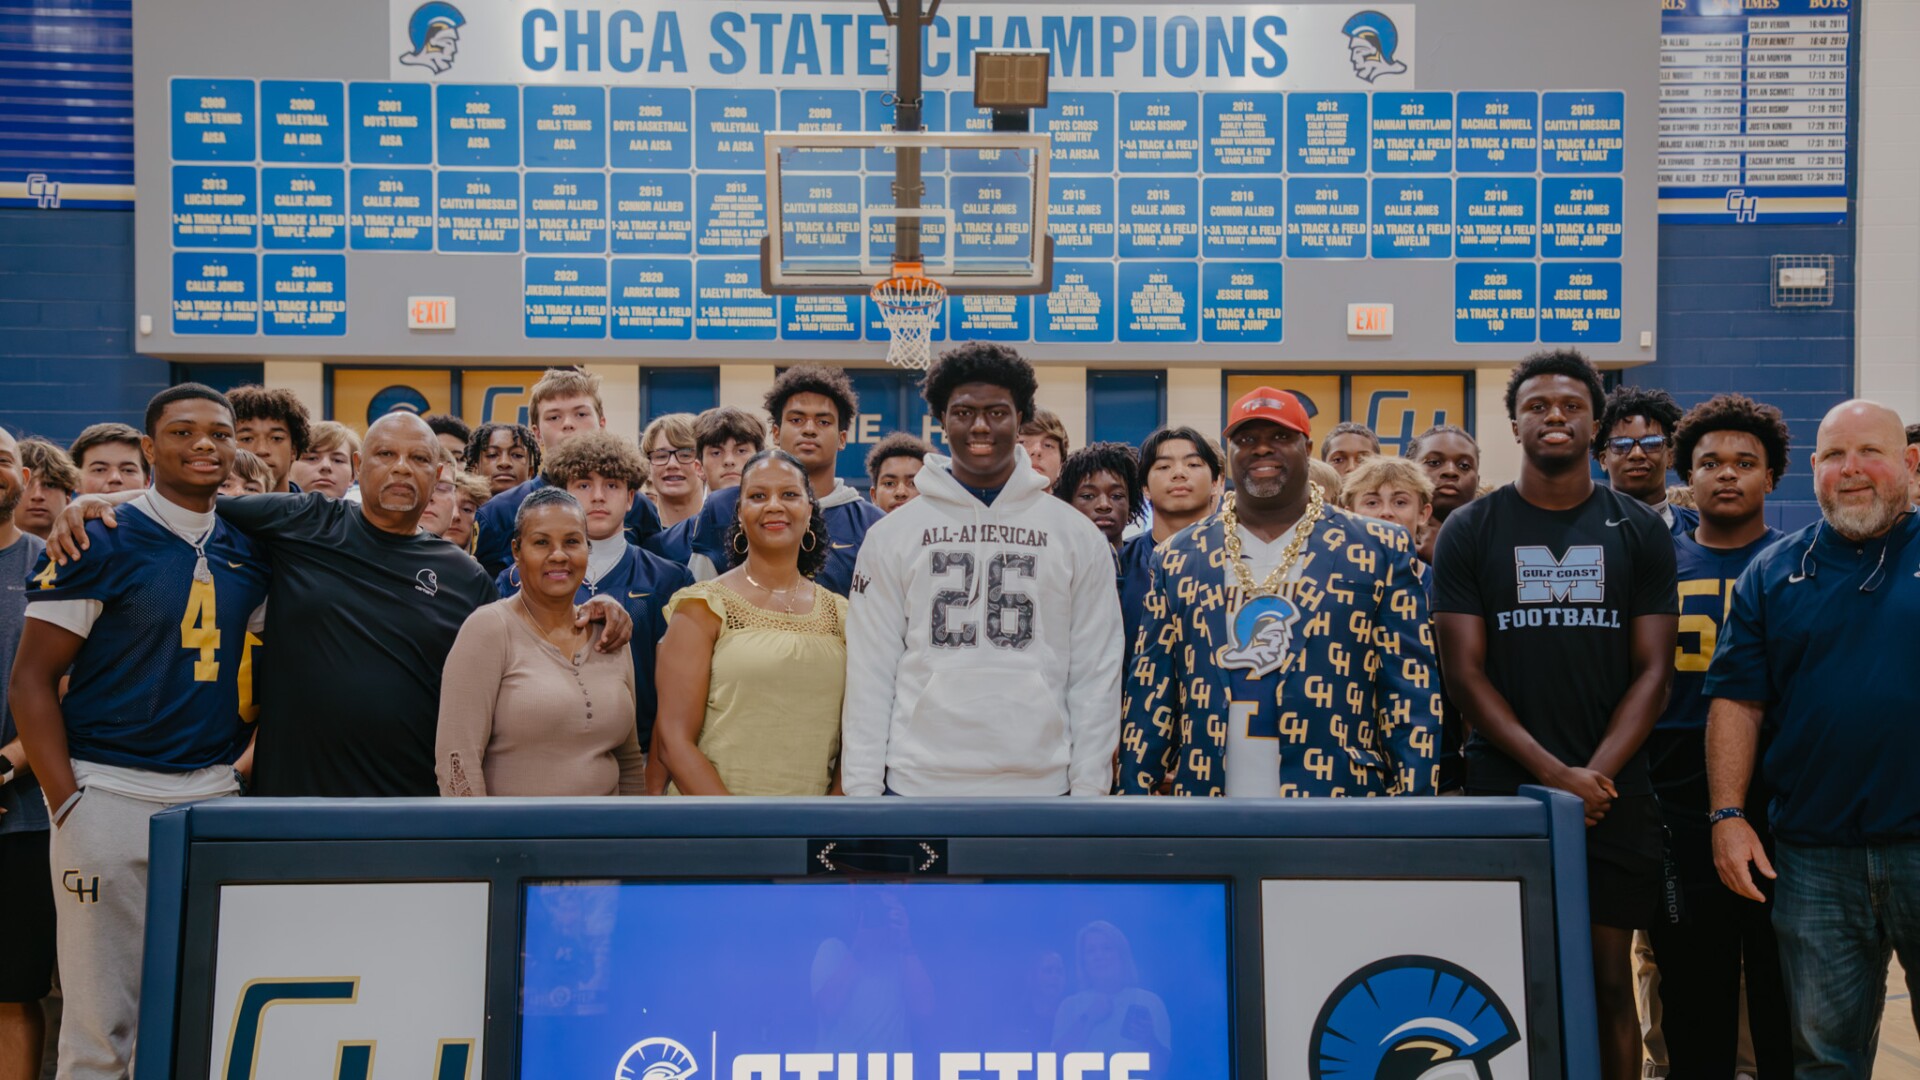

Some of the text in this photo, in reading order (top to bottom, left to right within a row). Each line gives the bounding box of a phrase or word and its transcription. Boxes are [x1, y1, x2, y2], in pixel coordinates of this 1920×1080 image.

[521, 9, 688, 73] CHCA
[708, 11, 889, 76] STATE
[466, 102, 490, 114] 2002
[1062, 105, 1084, 116] 2011
[1147, 105, 1170, 116] 2012
[1401, 104, 1424, 115] 2012
[1485, 104, 1509, 115] 2012
[1571, 104, 1595, 116] 2015
[212, 112, 242, 124] TENNIS
[276, 114, 328, 126] VOLLEYBALL
[363, 115, 418, 128] BOYS TENNIS
[450, 117, 506, 130] GIRLS TENNIS
[1461, 118, 1531, 130] RACHAEL HOWELL
[537, 119, 592, 131] GIRLS TENNIS
[613, 120, 687, 132] BOYS BASKETBALL
[711, 122, 759, 133] VOLLEYBALL
[1049, 120, 1098, 131] BOYS CROSS
[1130, 120, 1186, 131] LUCAS BISHOP
[1373, 119, 1451, 130] HANNAH WENTLAND
[1544, 119, 1620, 131] CAITLYN DRESSLER
[202, 131, 226, 144] AISA
[284, 133, 322, 145] AA AISA
[380, 134, 402, 147] AISA
[467, 137, 490, 149] AISA
[1055, 132, 1092, 142] COUNTRY
[554, 138, 576, 150] AISA
[630, 140, 672, 151] AAA AISA
[718, 141, 754, 152] AA AISA
[1138, 140, 1165, 151] TRACK
[1175, 139, 1197, 151] FIELD
[1373, 138, 1385, 150] 2A
[1386, 138, 1416, 150] TRACK
[1426, 138, 1451, 150] FIELD
[1458, 138, 1470, 149] 2A
[1471, 137, 1500, 150] TRACK
[1511, 137, 1536, 149] FIELD
[1543, 138, 1555, 150] 3A
[1556, 138, 1586, 150] TRACK
[1597, 138, 1622, 150] FIELD
[1069, 149, 1100, 160] AHSAA
[1387, 149, 1437, 161] HIGH JUMP
[1556, 149, 1607, 161] POLE VAULT
[553, 184, 577, 195] 2015
[1316, 189, 1338, 200] 2016
[532, 199, 598, 210] CONNOR ALLRED
[1295, 204, 1359, 215] CONNOR ALLRED
[525, 218, 538, 229] 3A
[539, 218, 569, 230] TRACK
[580, 218, 605, 230] FIELD
[1288, 223, 1300, 234] 3A
[1301, 223, 1331, 235] TRACK
[1341, 223, 1366, 234] FIELD
[539, 229, 591, 241] POLE VAULT
[1302, 234, 1352, 246] POLE VAULT
[1231, 274, 1254, 286] 2025
[1216, 288, 1268, 301] JESSIE GIBBS
[416, 301, 448, 324] EXIT
[1203, 308, 1216, 319] 3A
[1217, 308, 1246, 320] TRACK
[1256, 308, 1282, 320] FIELD
[1216, 319, 1267, 330] LONG JUMP
[1355, 307, 1387, 331] EXIT
[921, 524, 1048, 547] ALL-AMERICAN
[1522, 569, 1598, 578] GULF COAST
[929, 550, 1038, 650] 26
[1497, 607, 1620, 631] FOOTBALL
[180, 574, 221, 682] 4
